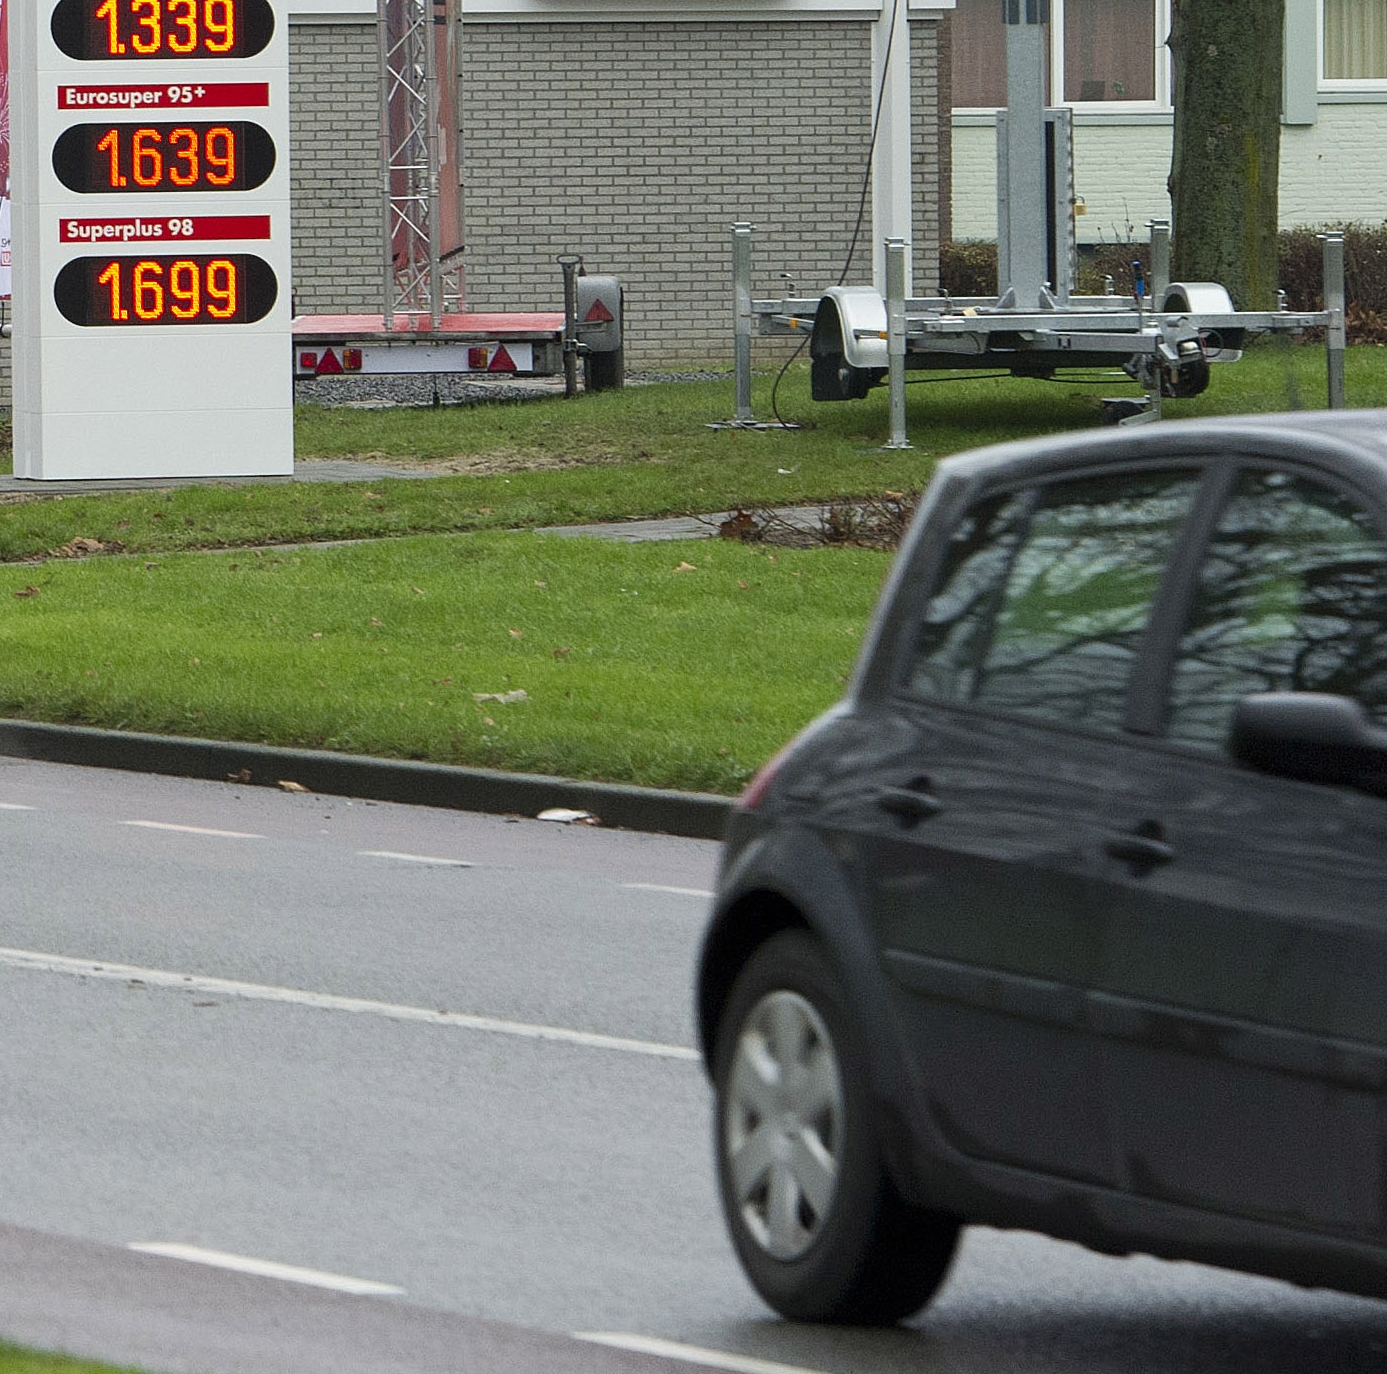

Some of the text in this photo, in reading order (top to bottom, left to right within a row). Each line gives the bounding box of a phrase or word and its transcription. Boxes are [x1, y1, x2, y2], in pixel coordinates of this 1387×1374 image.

[66, 85, 206, 108] Eurosuper 95+
[96, 126, 235, 187] 1.639
[67, 219, 194, 242] Superplus 98
[97, 260, 237, 320] 1.699
